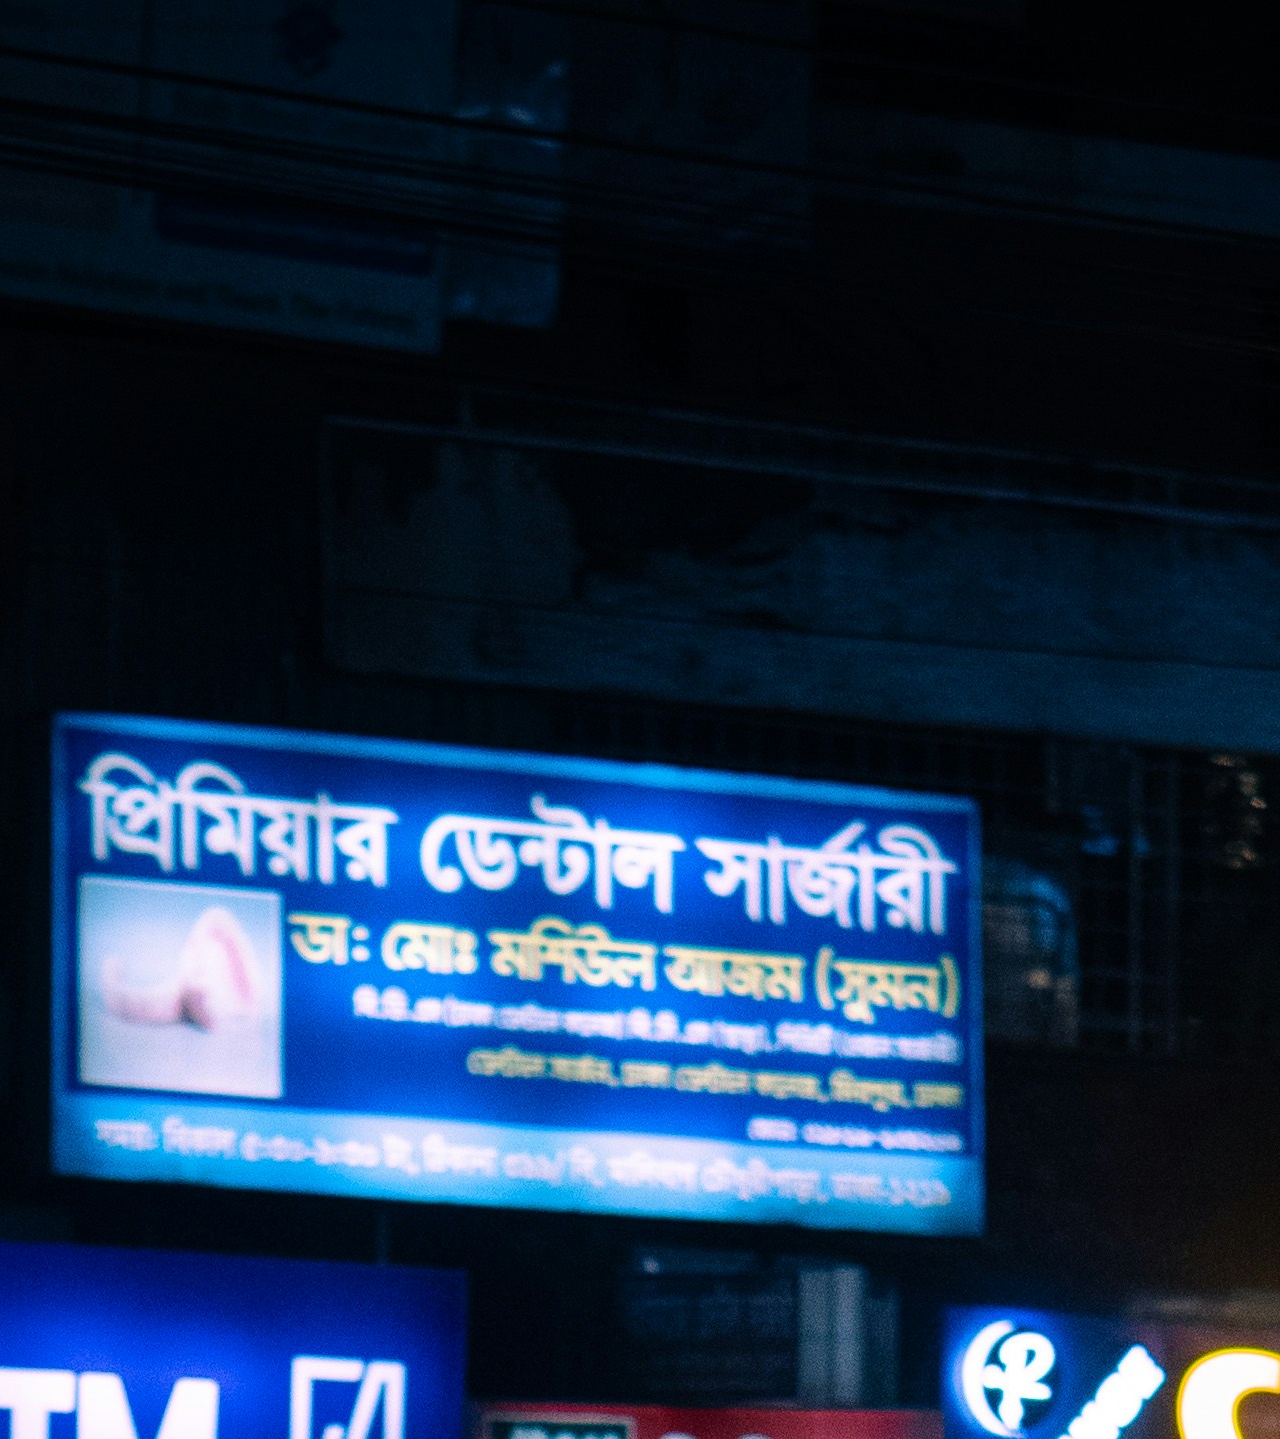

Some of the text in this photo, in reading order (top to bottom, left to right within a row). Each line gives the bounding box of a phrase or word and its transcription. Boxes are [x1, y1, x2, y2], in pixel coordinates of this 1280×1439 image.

[81, 753, 957, 934] প্রিমিয়ার ডেন্টাল সার্জারী
